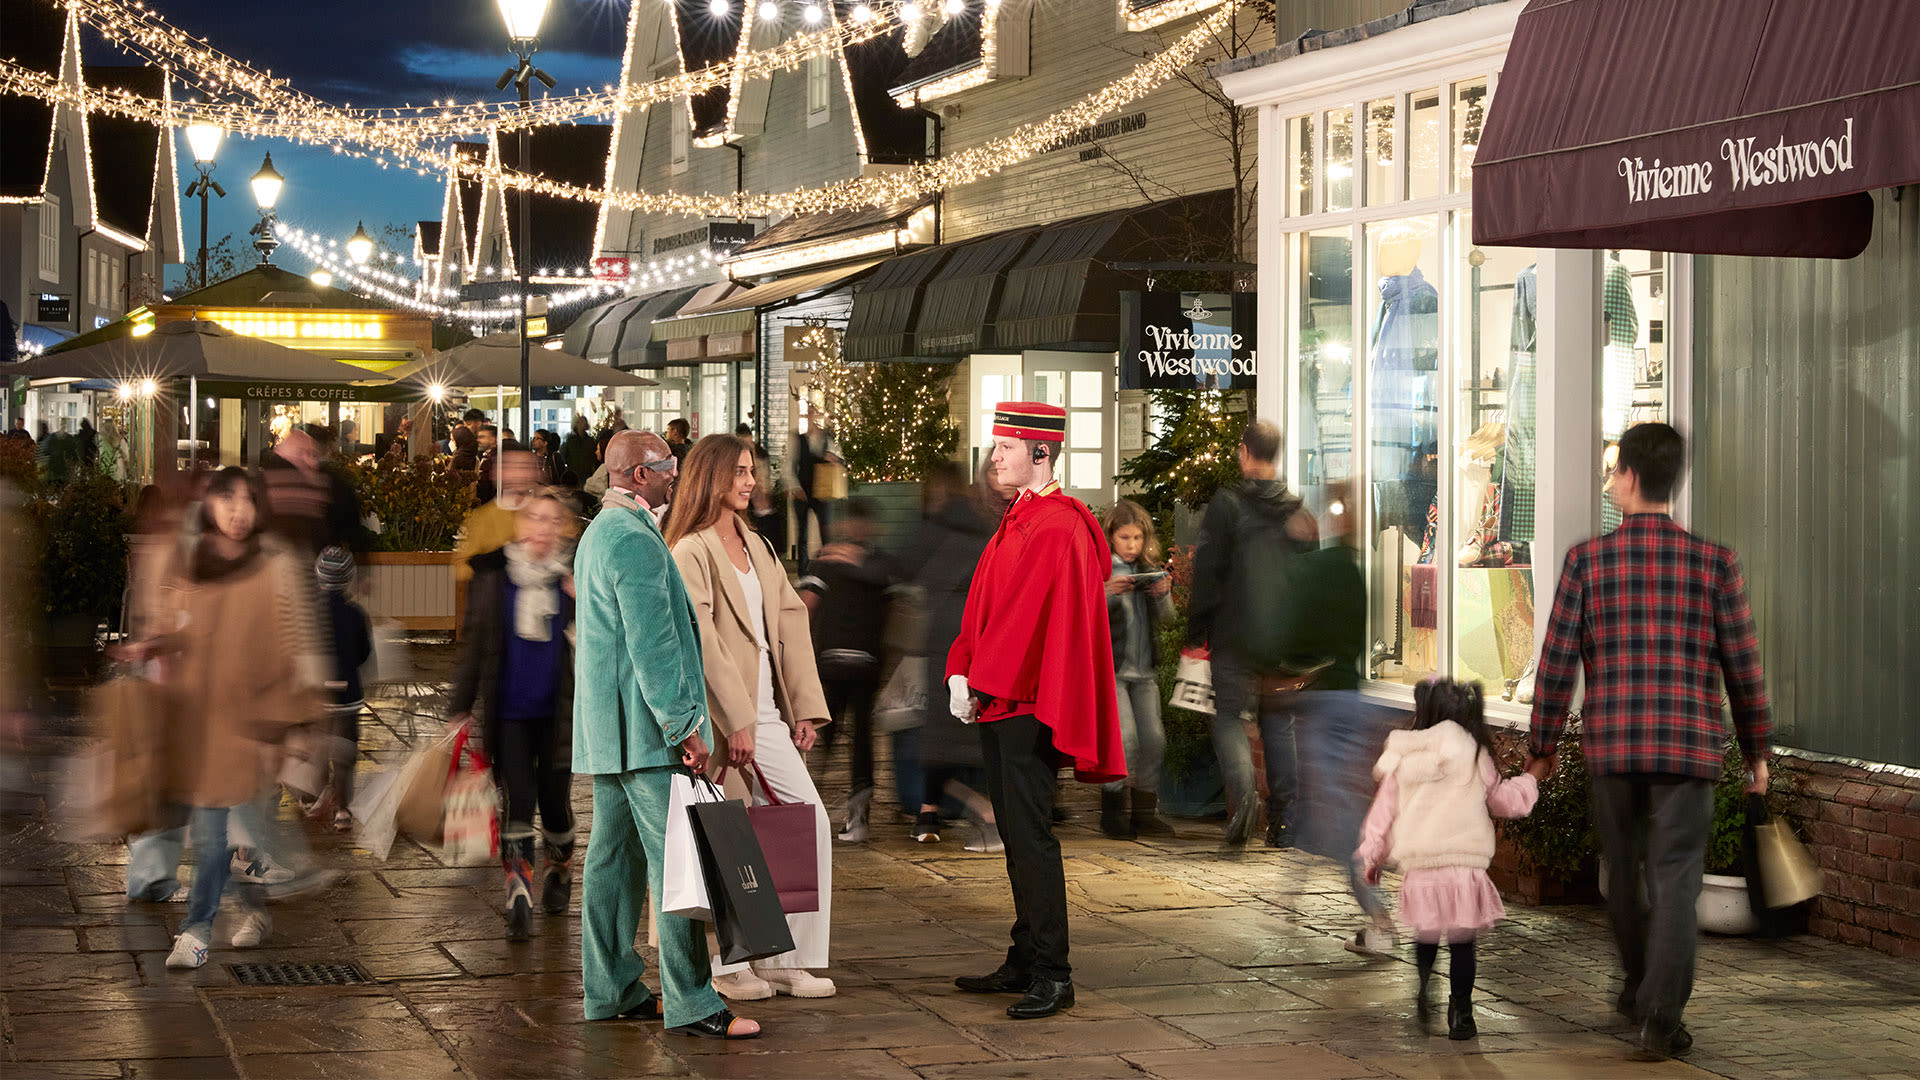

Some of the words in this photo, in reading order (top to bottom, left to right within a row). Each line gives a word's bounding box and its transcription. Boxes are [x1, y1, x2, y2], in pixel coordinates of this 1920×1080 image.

[1092, 119, 1120, 139] DELUXE
[1121, 112, 1147, 135] BRAND
[1617, 156, 1713, 205] Vivienne
[1720, 117, 1854, 192] Westwood
[713, 235, 728, 244] Paul
[730, 236, 746, 244] Smith
[1145, 324, 1243, 351] Vivienne
[1138, 350, 1257, 378] Westwood
[247, 385, 292, 398] CRÊPES
[297, 388, 305, 398] &
[310, 388, 355, 399] COFFEE
